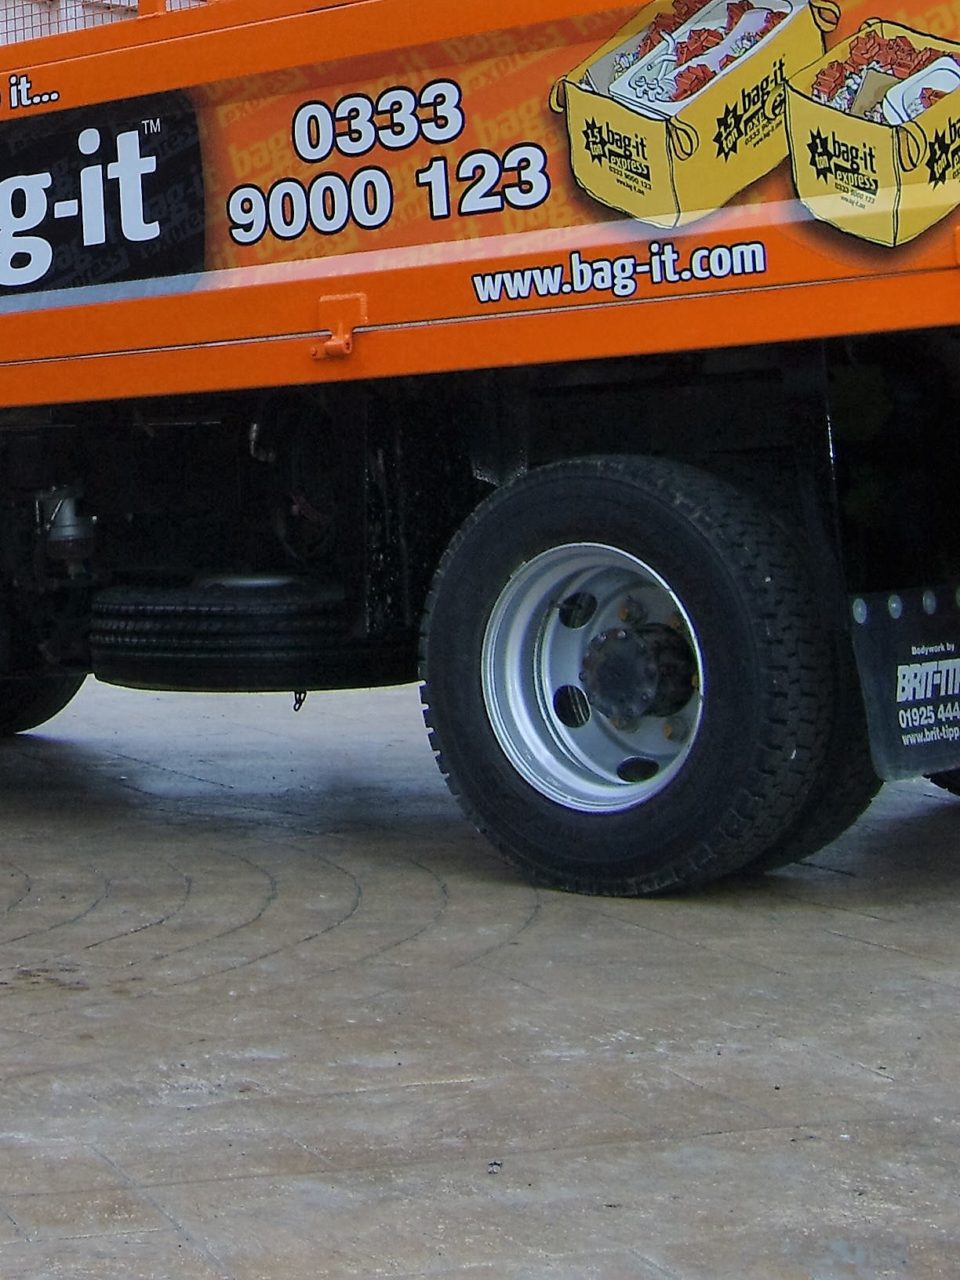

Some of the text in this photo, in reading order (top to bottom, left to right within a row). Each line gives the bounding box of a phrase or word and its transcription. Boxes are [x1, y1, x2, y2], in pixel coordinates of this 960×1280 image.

[9, 75, 60, 108] it...
[293, 79, 465, 164] 0333
[606, 121, 647, 160] bag-it
[611, 157, 647, 175] express
[832, 131, 876, 174] bag-it
[227, 142, 551, 246] 9000 123
[837, 171, 876, 190] express
[472, 241, 766, 302] www.bag-it.com
[899, 705, 935, 729] 01925
